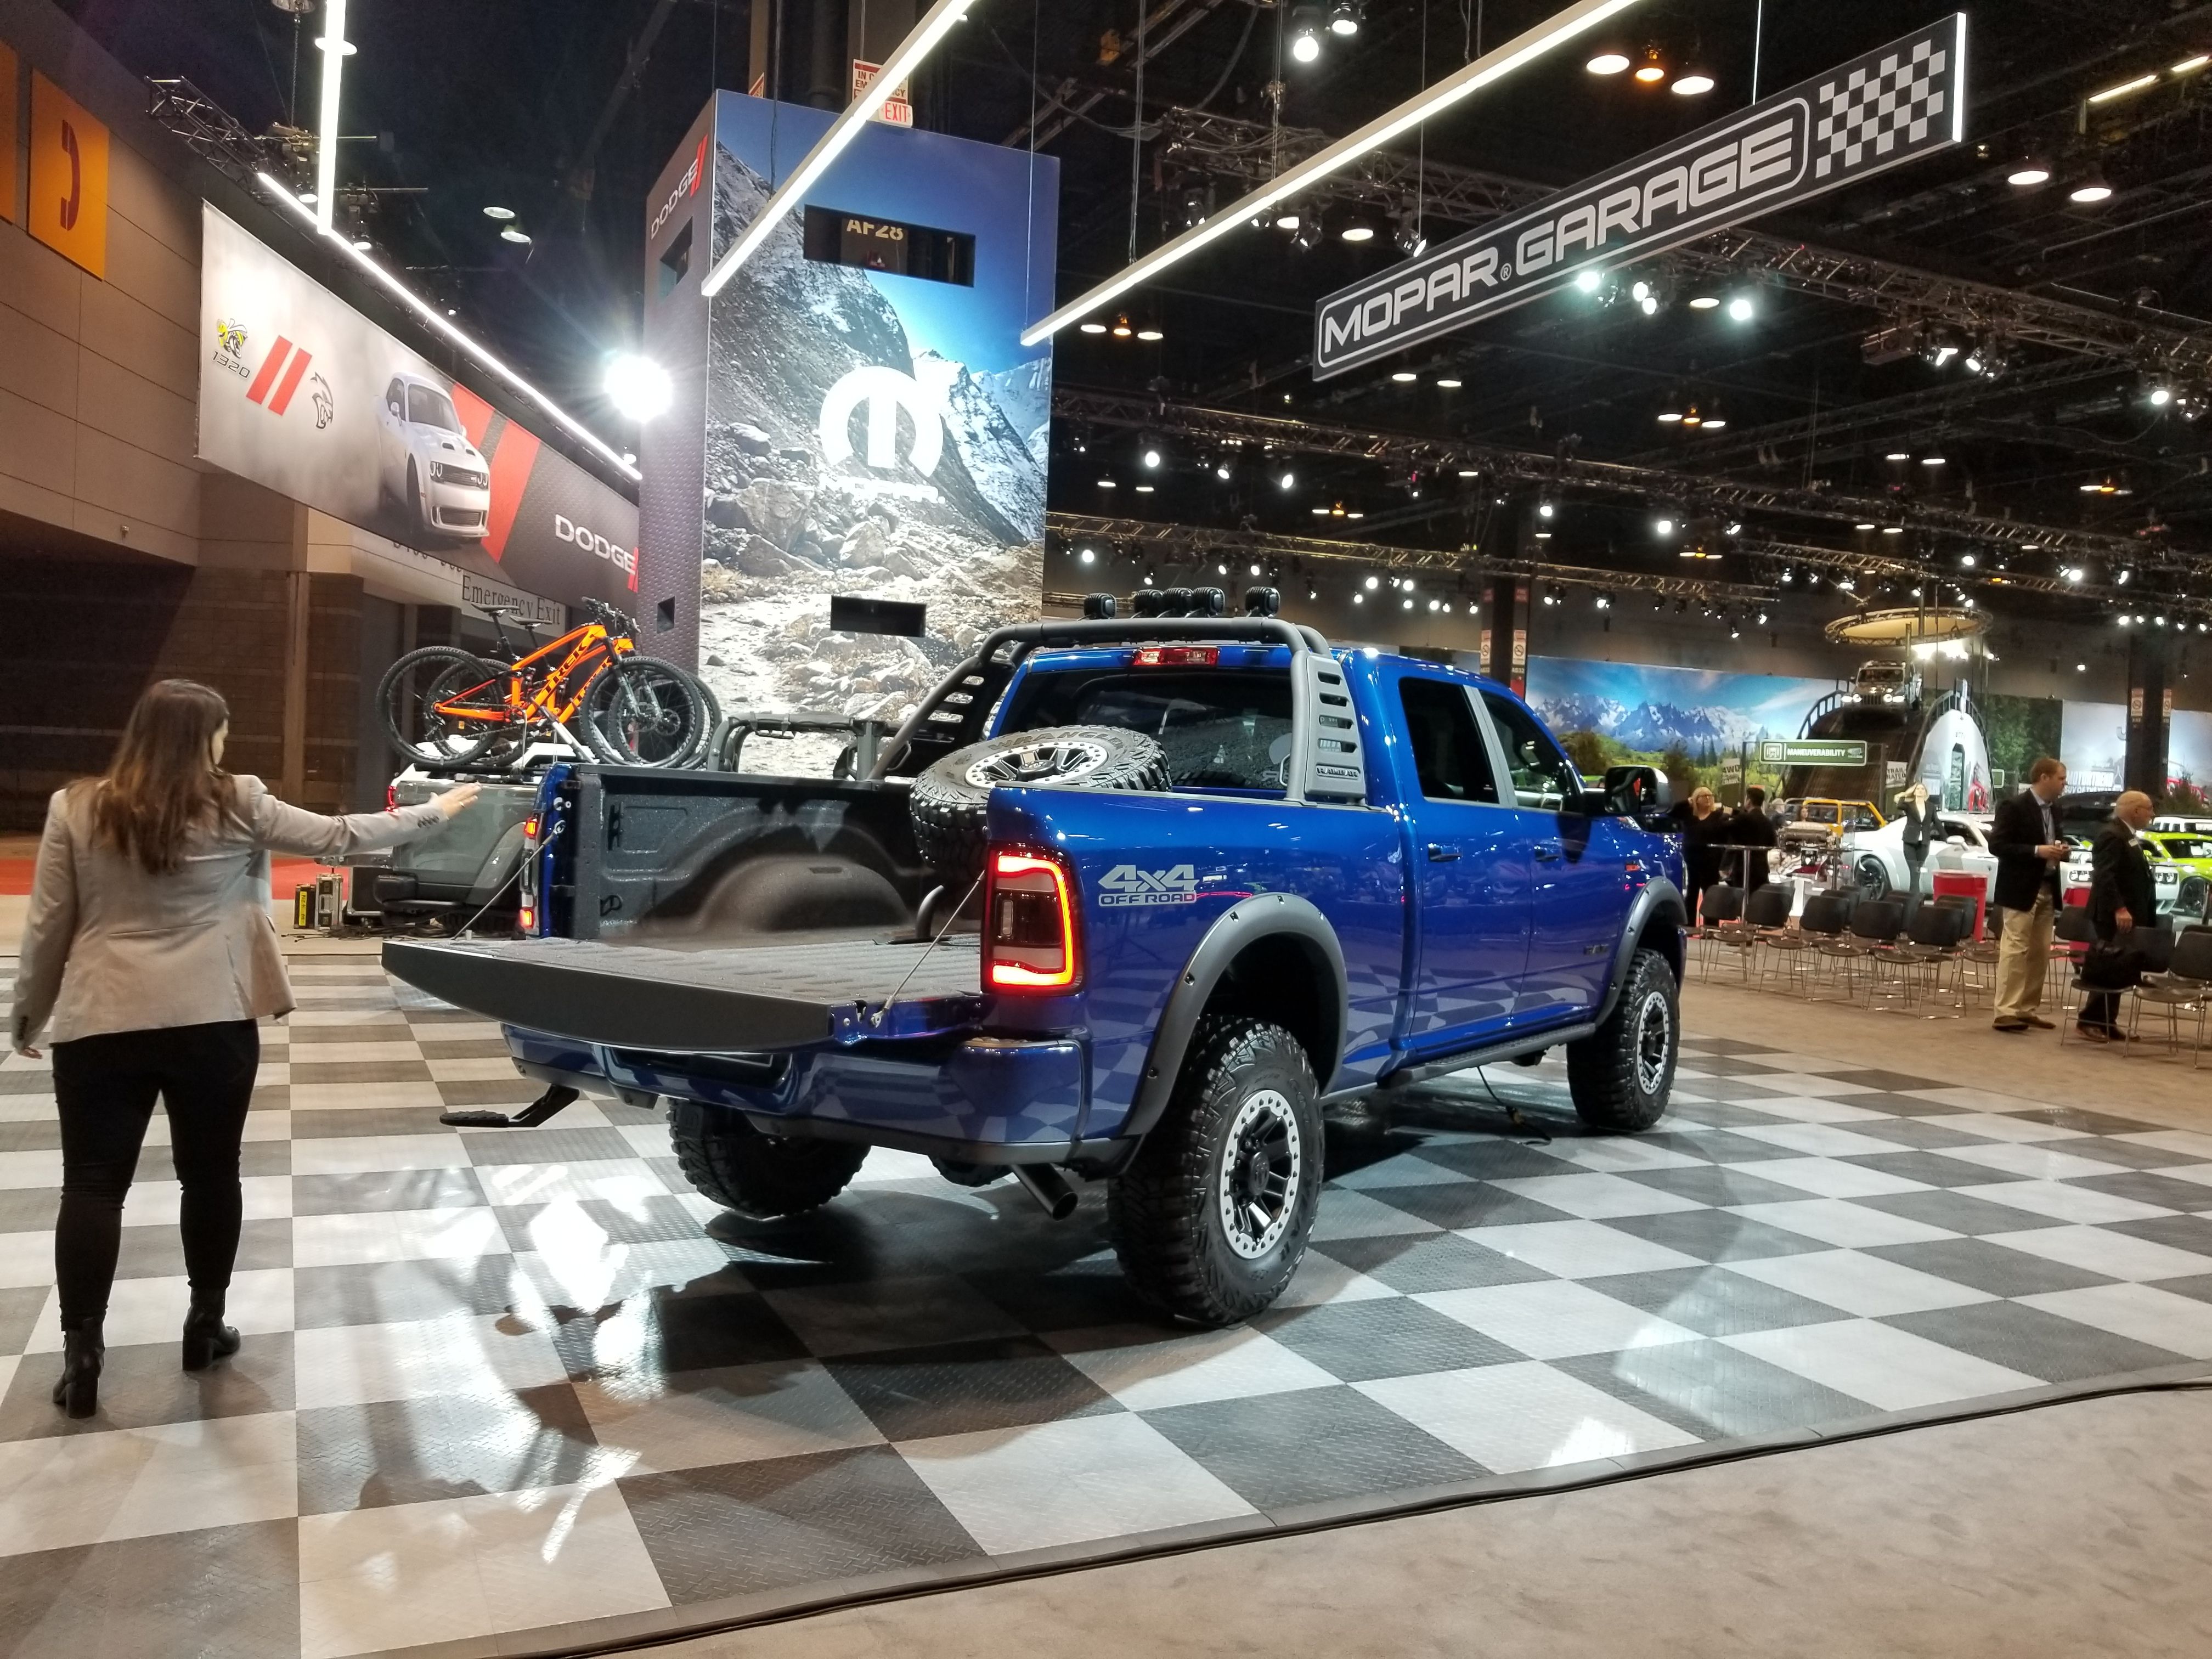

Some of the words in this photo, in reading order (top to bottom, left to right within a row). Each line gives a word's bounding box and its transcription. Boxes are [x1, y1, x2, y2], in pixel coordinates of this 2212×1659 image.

[857, 70, 866, 80] IN
[884, 102, 907, 123] EXIT
[651, 158, 698, 240] DODGE
[1516, 118, 1793, 275] GARAGE
[212, 350, 251, 379] 1320
[555, 514, 636, 575] DODGE
[461, 574, 534, 619] Emergency
[536, 596, 561, 626] Exit
[543, 642, 588, 694] TREK
[1787, 748, 1846, 757] MANEUVERABILITY
[1101, 895, 1142, 905] OFF
[1144, 893, 1195, 904] ROAD
